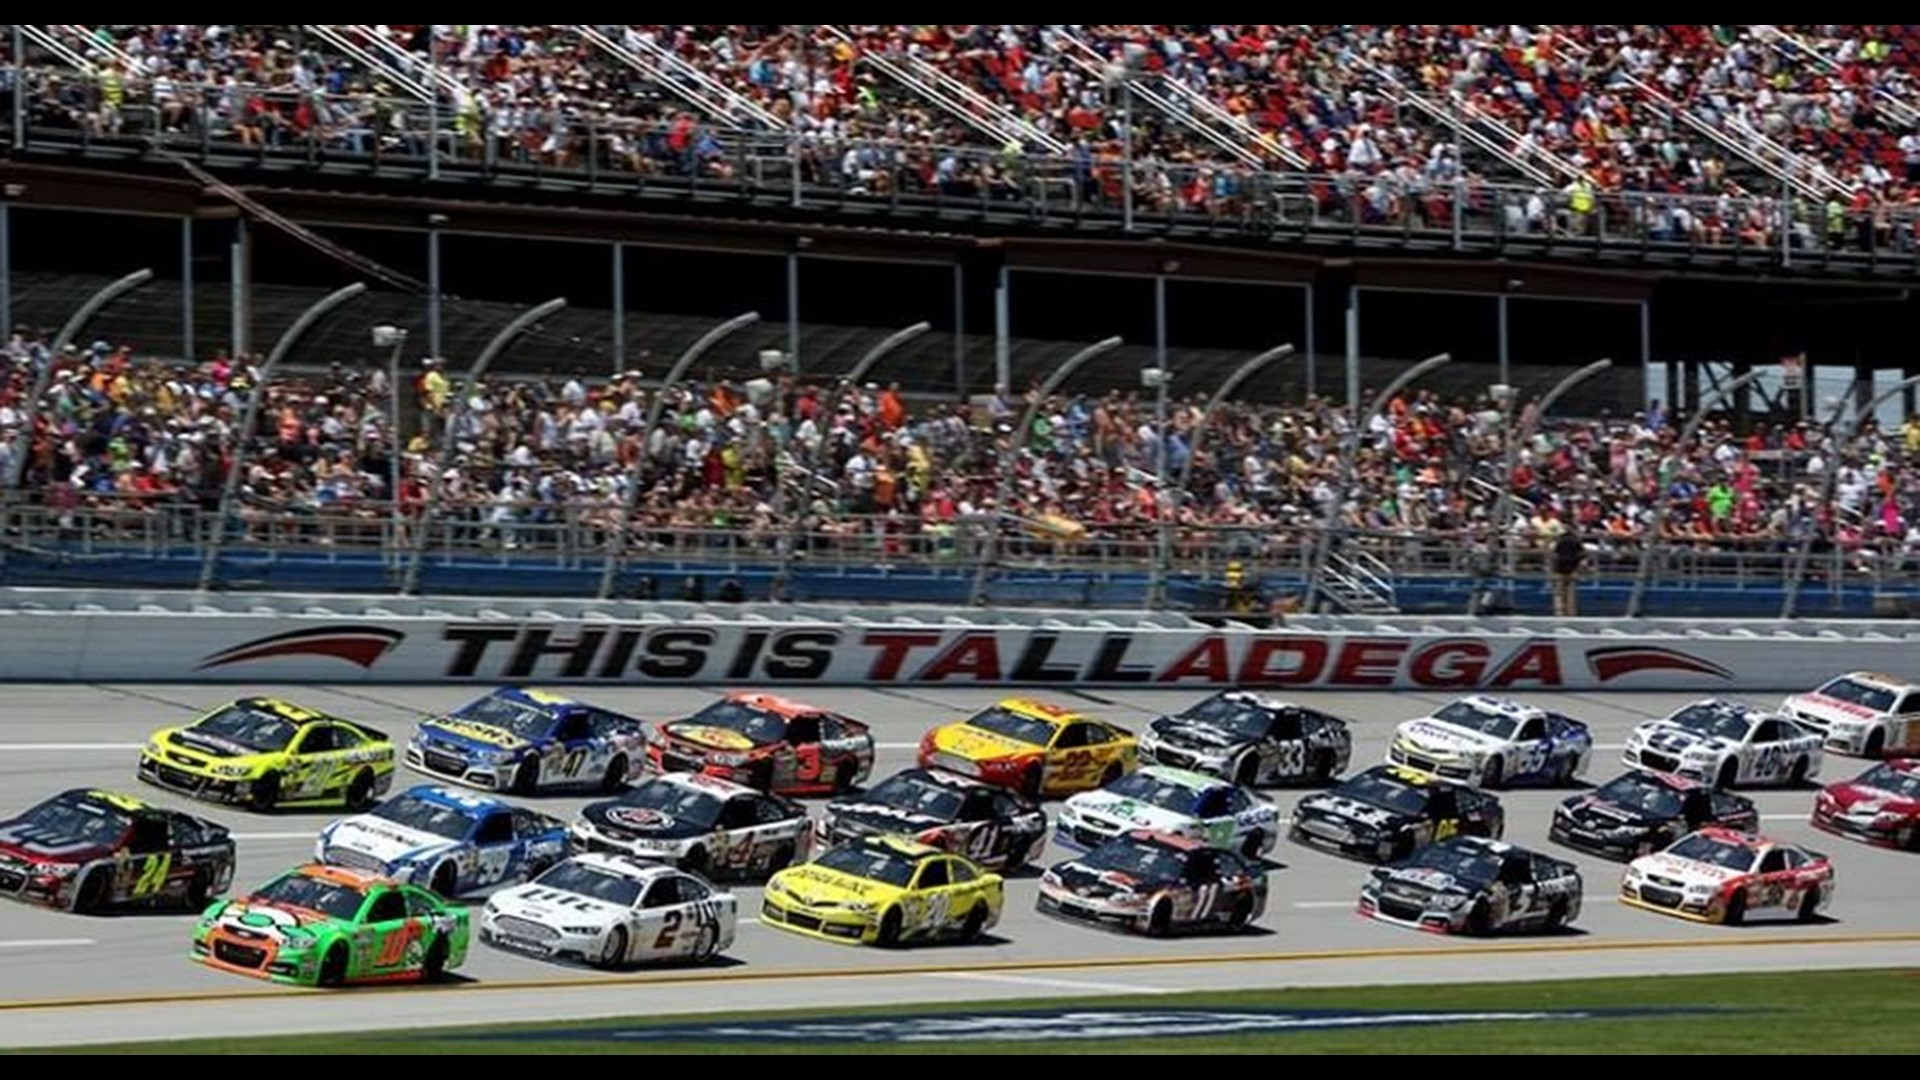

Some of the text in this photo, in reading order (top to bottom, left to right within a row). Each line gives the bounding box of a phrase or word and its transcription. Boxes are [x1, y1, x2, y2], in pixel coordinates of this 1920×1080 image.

[444, 623, 1565, 686] THIS IS TALLADEGA
[562, 747, 588, 778] 47
[796, 742, 821, 779] 3
[1277, 739, 1305, 775] 33
[729, 831, 757, 864] 4
[133, 852, 172, 896] 24
[1191, 884, 1218, 919] 11
[653, 910, 684, 950] 2
